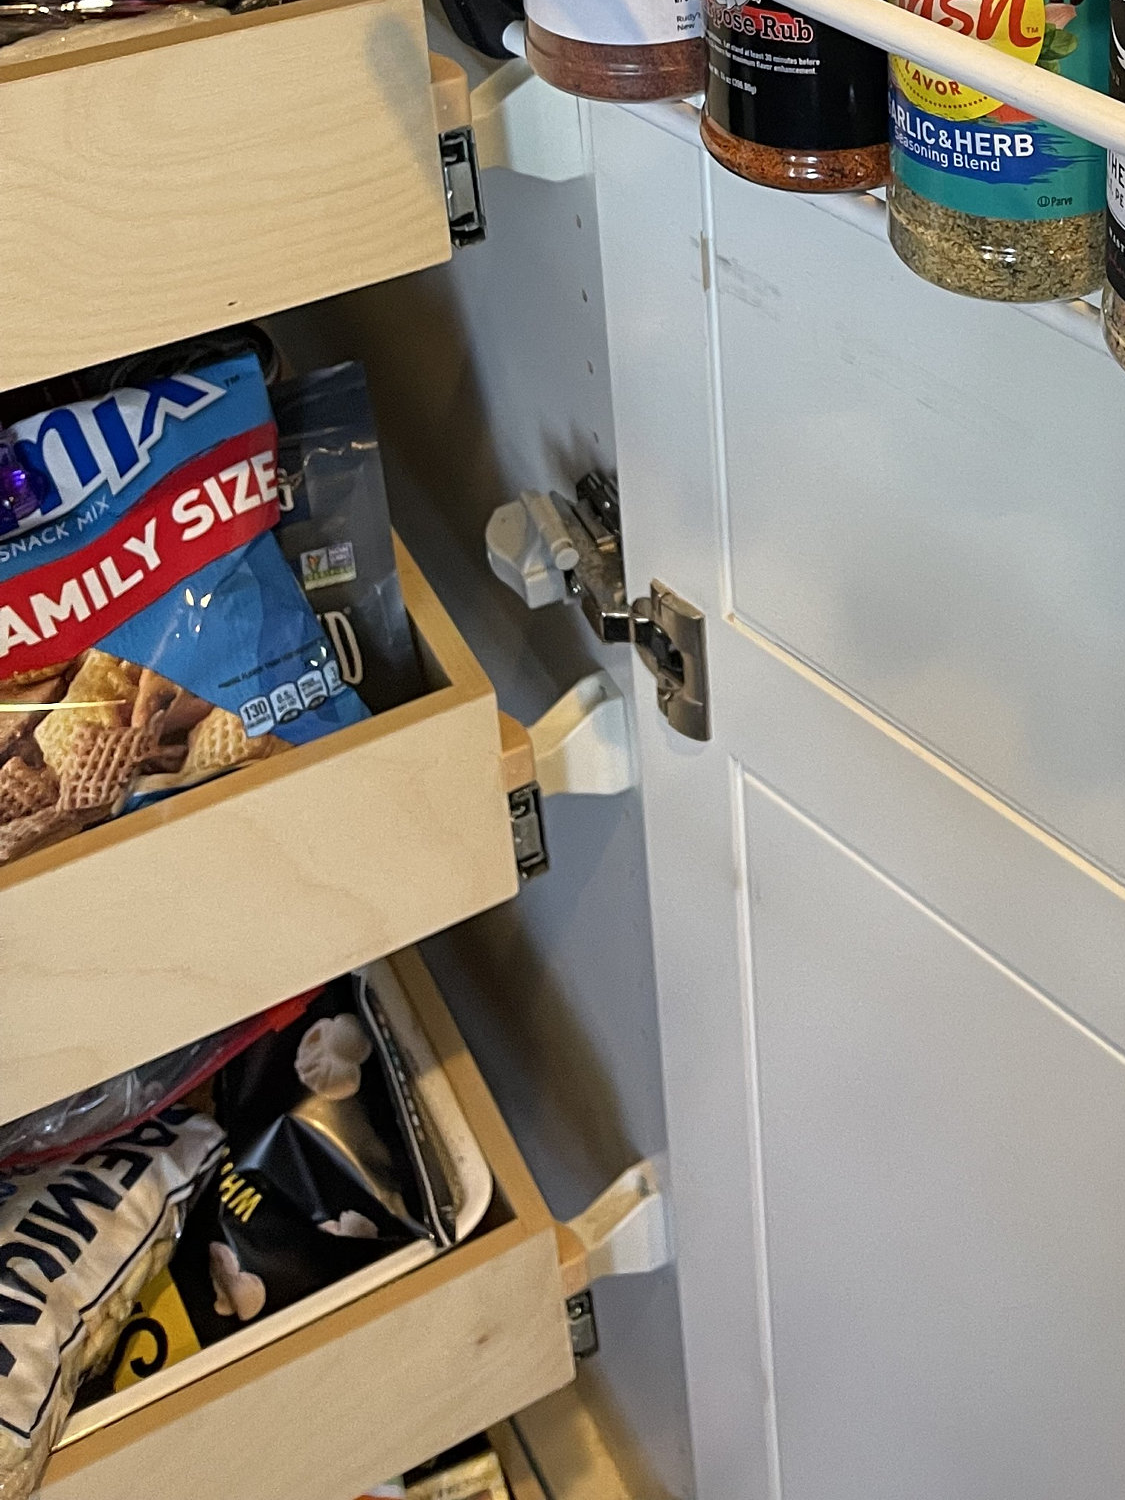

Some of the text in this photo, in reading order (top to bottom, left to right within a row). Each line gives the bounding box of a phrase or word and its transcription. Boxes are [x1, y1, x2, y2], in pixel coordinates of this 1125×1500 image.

[760, 14, 814, 44] Rub
[904, 59, 963, 97] LAVOR
[889, 99, 1035, 158] ARLIC & HERB
[894, 124, 1001, 172] Seasoning Blend
[0, 494, 111, 563] SNACK MIX
[0, 450, 279, 658] AMILY SIZE
[243, 699, 268, 721] 130
